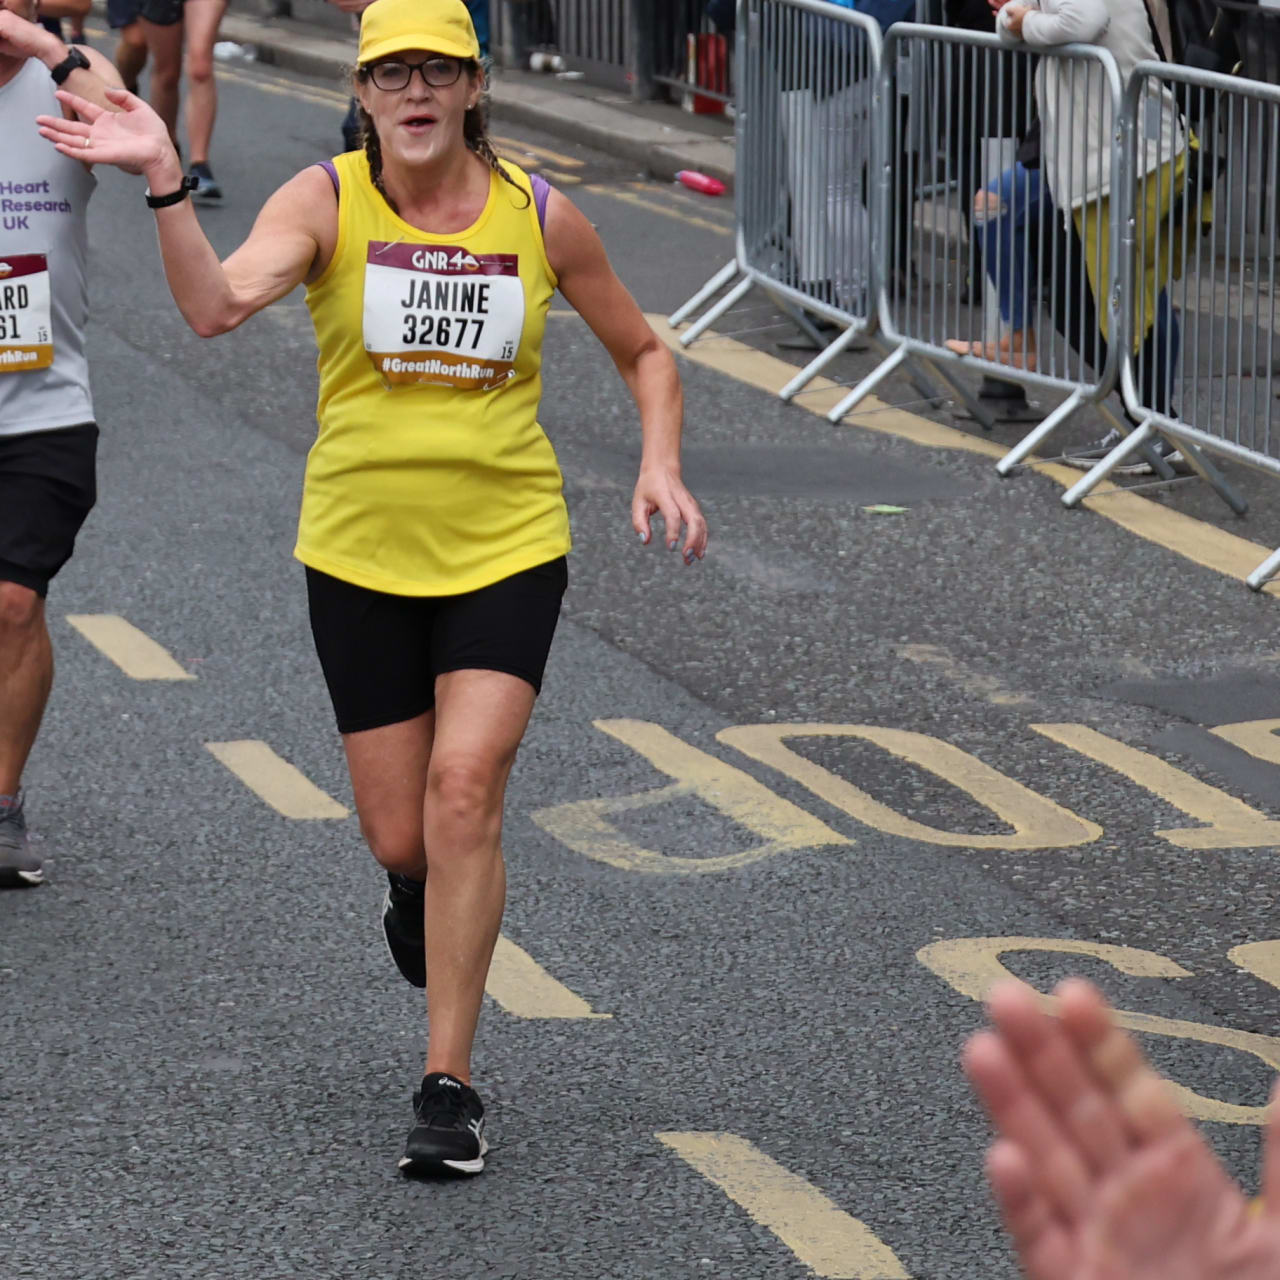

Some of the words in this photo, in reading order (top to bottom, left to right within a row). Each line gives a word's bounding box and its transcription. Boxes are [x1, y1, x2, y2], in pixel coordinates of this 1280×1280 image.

[0, 180, 50, 195] Heart
[1, 199, 72, 213] Research
[3, 216, 30, 230] UK
[401, 279, 490, 314] JANINE
[403, 314, 484, 349] 32677
[501, 346, 514, 359] 15
[382, 357, 494, 378] #GreatNorthRun
